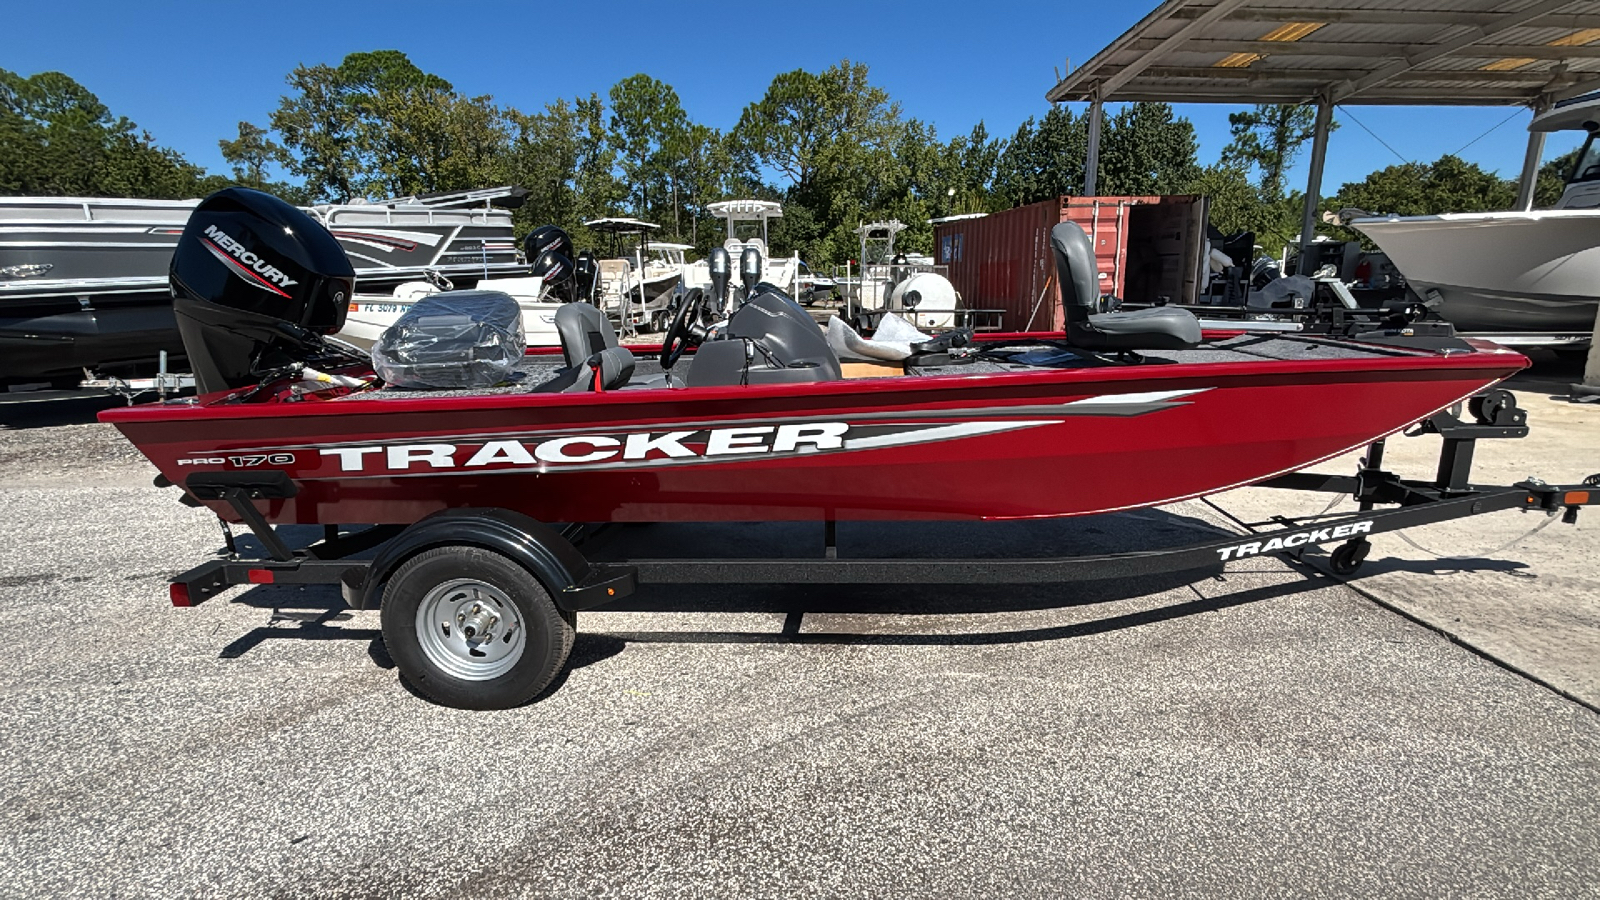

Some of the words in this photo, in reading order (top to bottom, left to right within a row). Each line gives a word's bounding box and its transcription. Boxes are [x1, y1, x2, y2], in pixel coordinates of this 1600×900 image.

[204, 224, 299, 288] MERCURY
[364, 303, 375, 313] FL
[177, 457, 226, 466] PRO
[228, 453, 296, 467] 170
[319, 422, 850, 471] TRACKER
[1216, 520, 1374, 561] TRACKER
